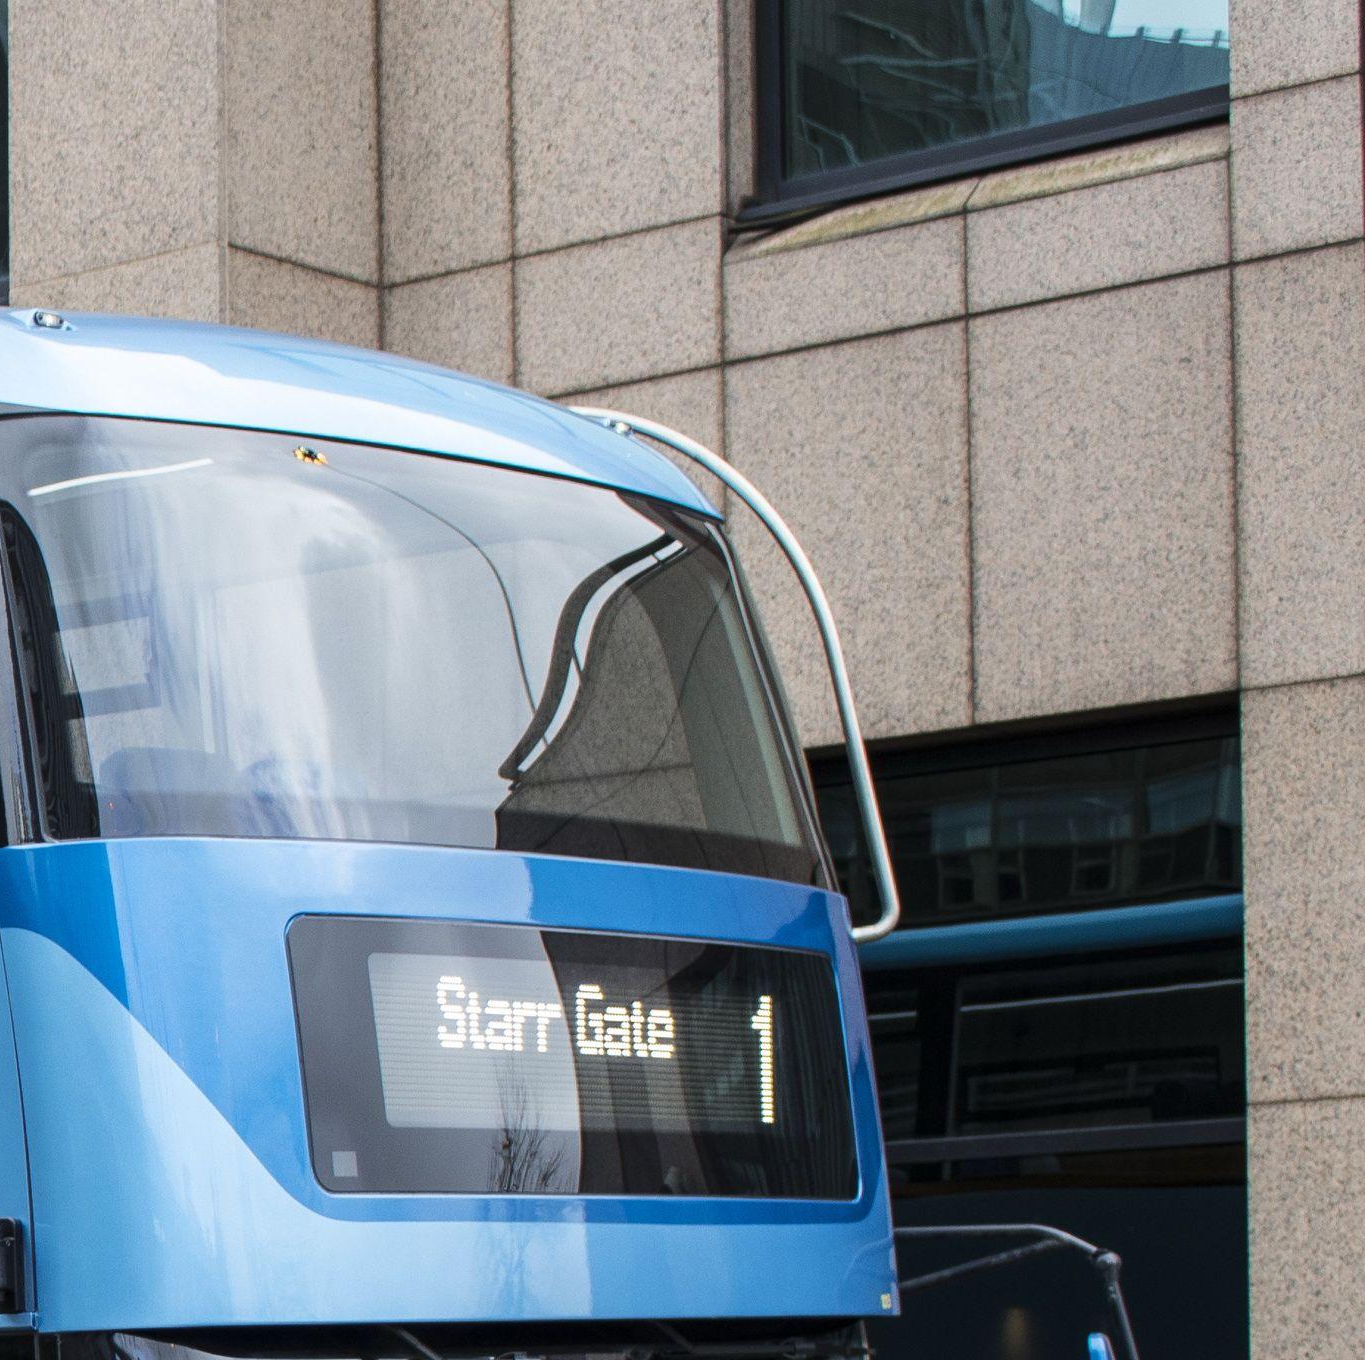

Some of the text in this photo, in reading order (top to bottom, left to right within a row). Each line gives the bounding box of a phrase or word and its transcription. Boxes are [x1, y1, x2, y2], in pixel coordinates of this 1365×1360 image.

[436, 975, 775, 1124] Starr Gate 1
